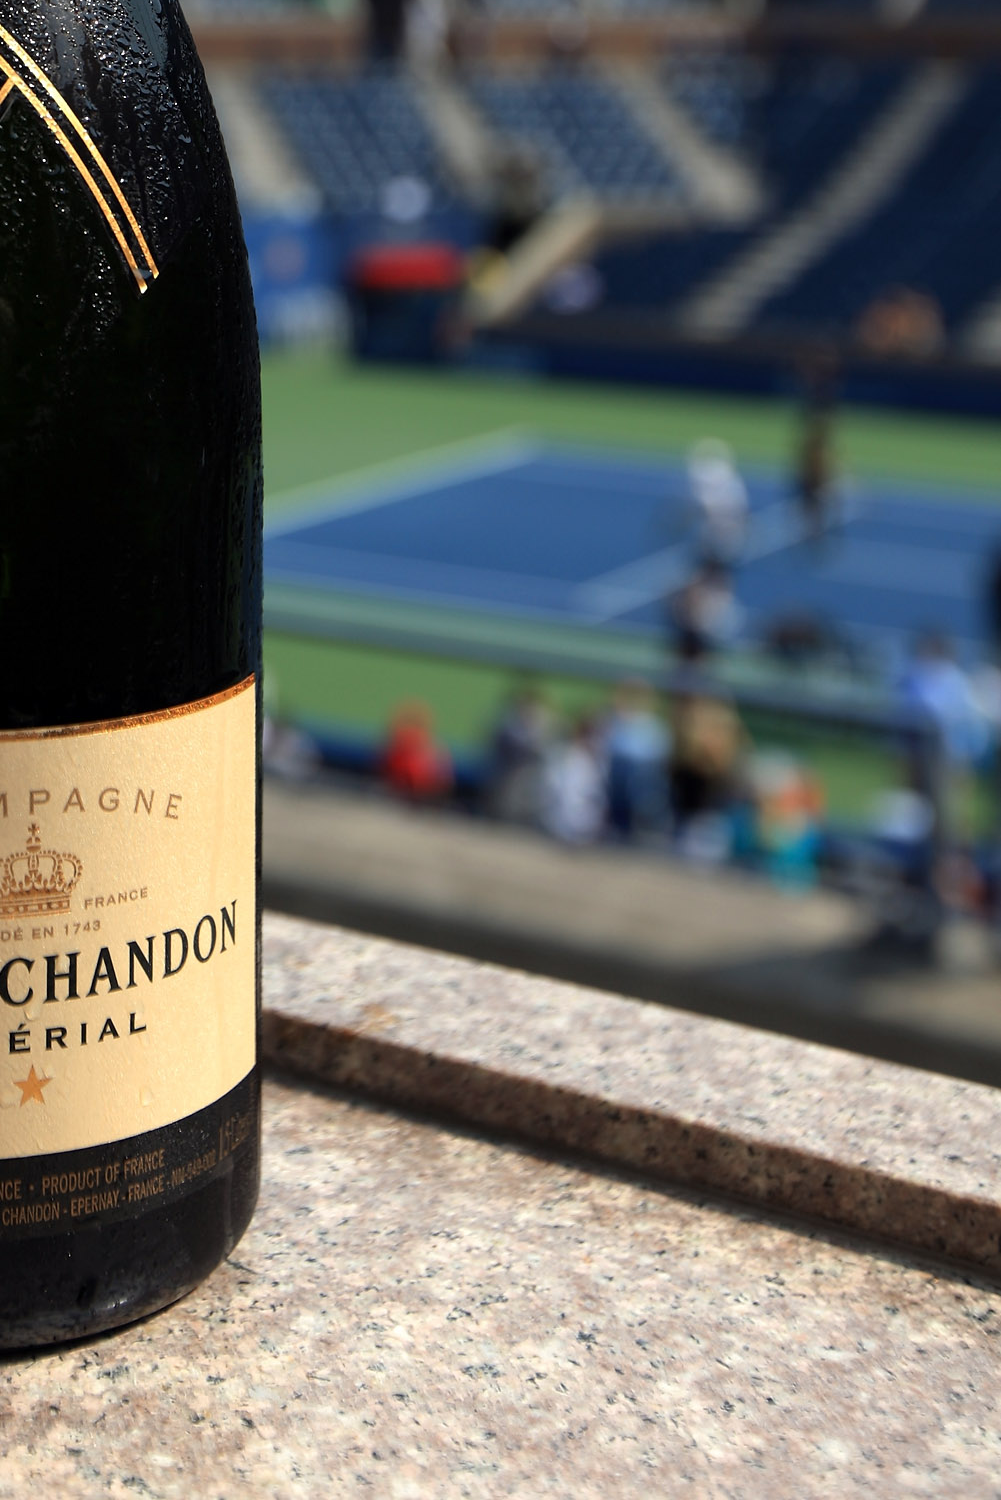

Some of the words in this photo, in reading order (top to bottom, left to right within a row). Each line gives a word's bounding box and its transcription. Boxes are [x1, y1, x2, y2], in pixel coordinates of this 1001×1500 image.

[84, 887, 149, 910] FRANCE
[32, 926, 55, 941] EN
[64, 920, 102, 936] 1743
[42, 1167, 102, 1197] PRODUCT
[105, 1162, 121, 1185] OF
[123, 1147, 166, 1181] FRANCE
[2, 1201, 61, 1227] CHANDON
[70, 1188, 121, 1218] EPERNAY
[127, 1174, 165, 1203] FRANCE
